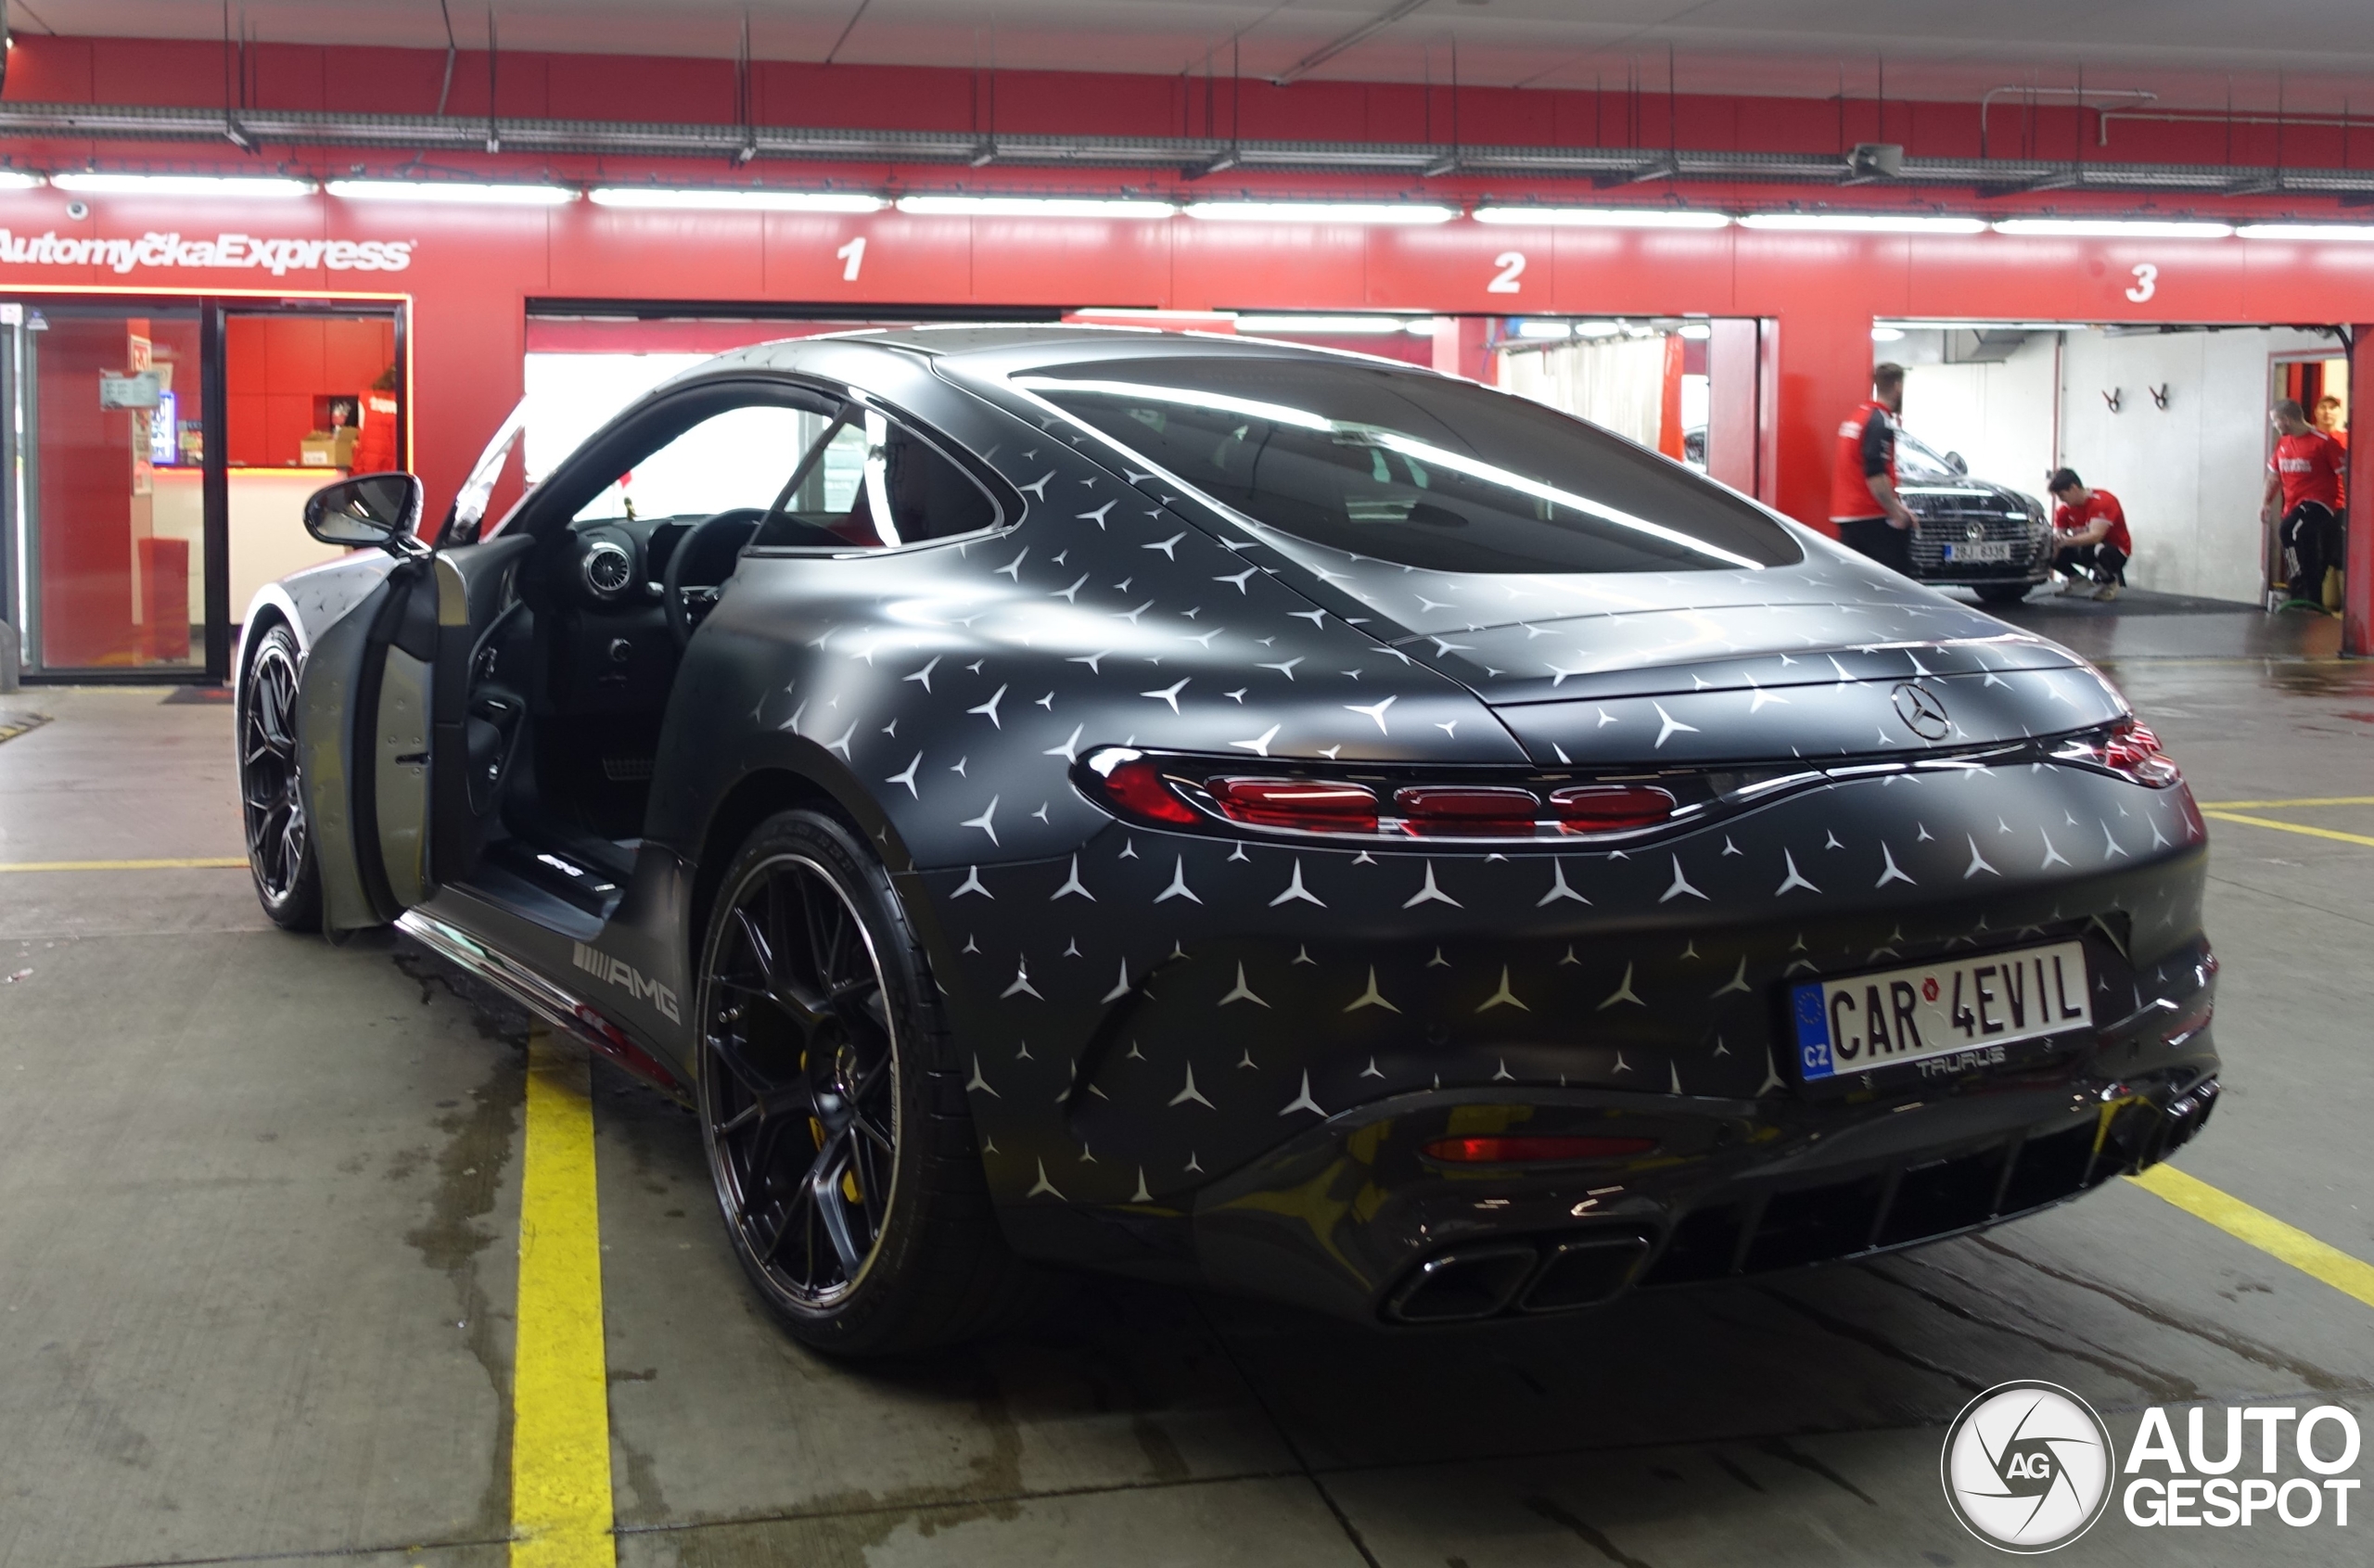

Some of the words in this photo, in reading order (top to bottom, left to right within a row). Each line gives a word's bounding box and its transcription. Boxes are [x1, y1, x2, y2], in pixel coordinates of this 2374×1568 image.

[836, 236, 866, 282] 1
[1487, 251, 1526, 294] 2
[2125, 263, 2158, 303] 3
[605, 956, 682, 1026] AMG
[1830, 980, 1922, 1061] CAR
[1951, 954, 2082, 1039] 4EVIL
[1804, 1044, 1830, 1068] CZ
[1915, 1046, 2006, 1078] TAURUS
